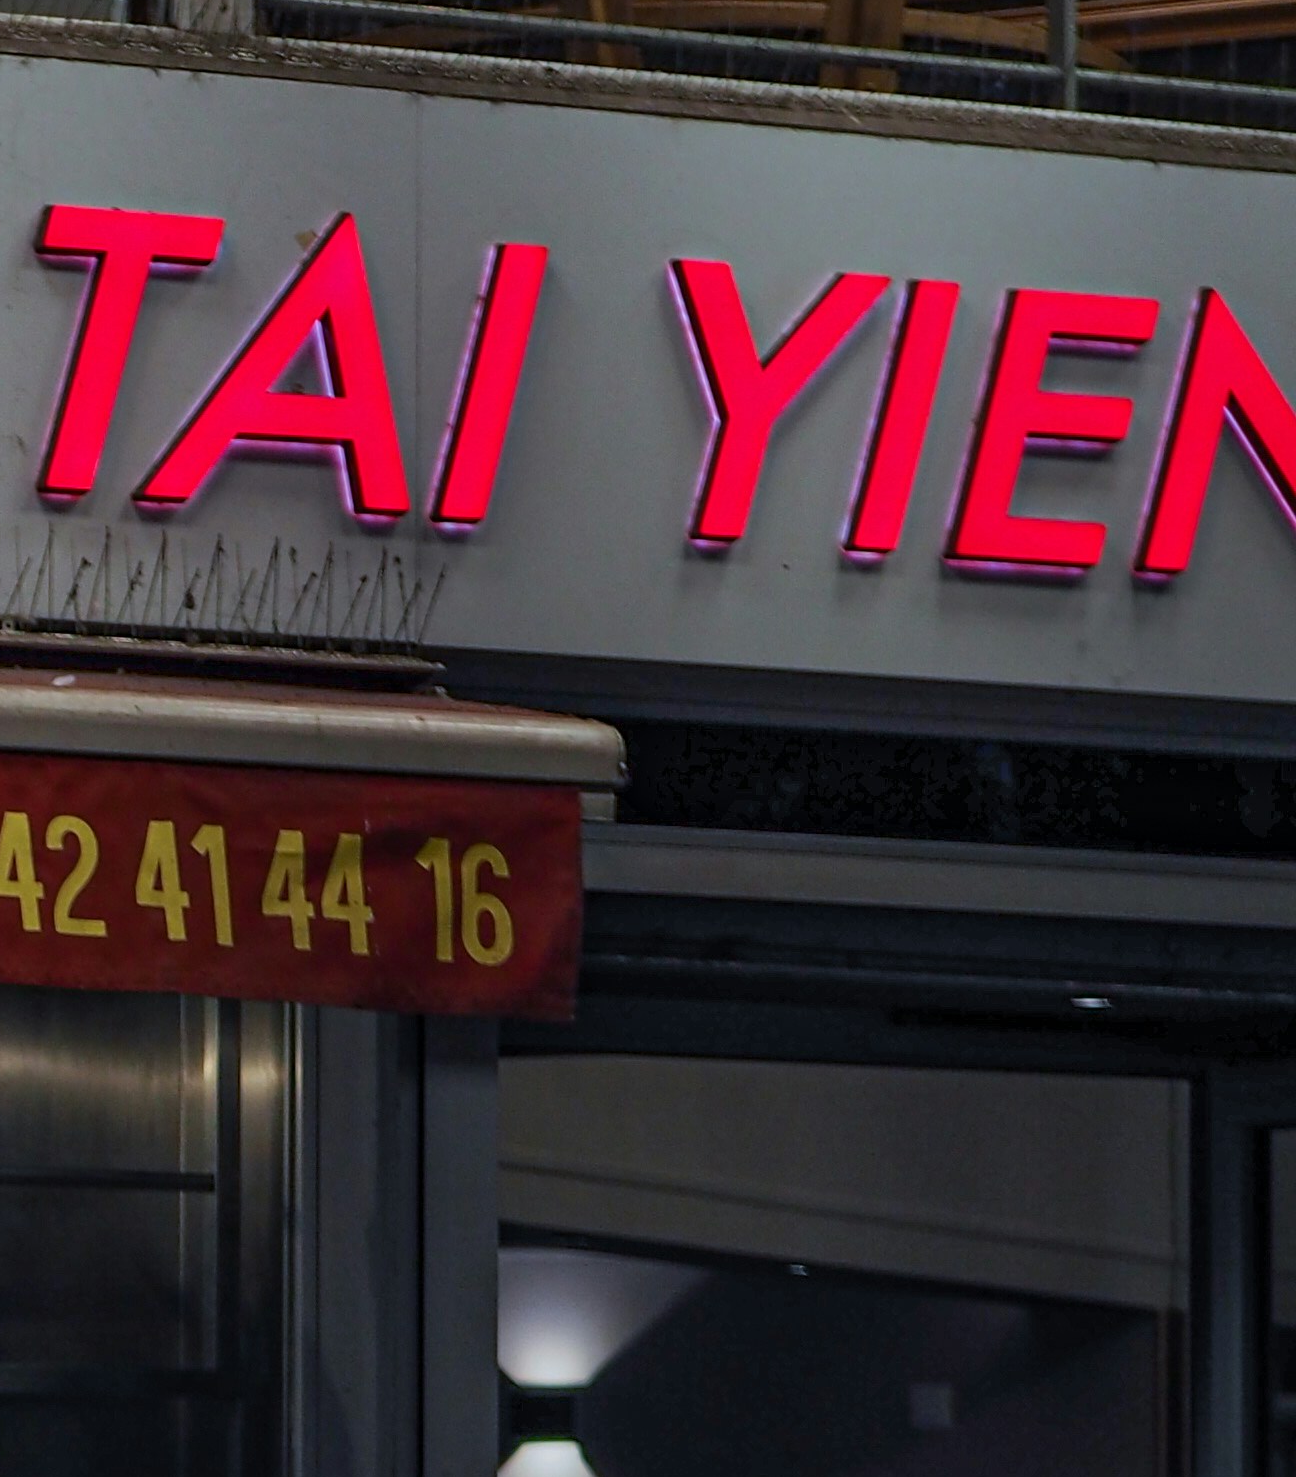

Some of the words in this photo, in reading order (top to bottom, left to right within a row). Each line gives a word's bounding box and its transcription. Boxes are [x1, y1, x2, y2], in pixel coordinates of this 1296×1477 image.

[34, 203, 548, 523] TAI
[670, 258, 1296, 573] YIEN
[134, 821, 234, 947] 41
[261, 829, 374, 955] 44
[414, 838, 516, 967] 16
